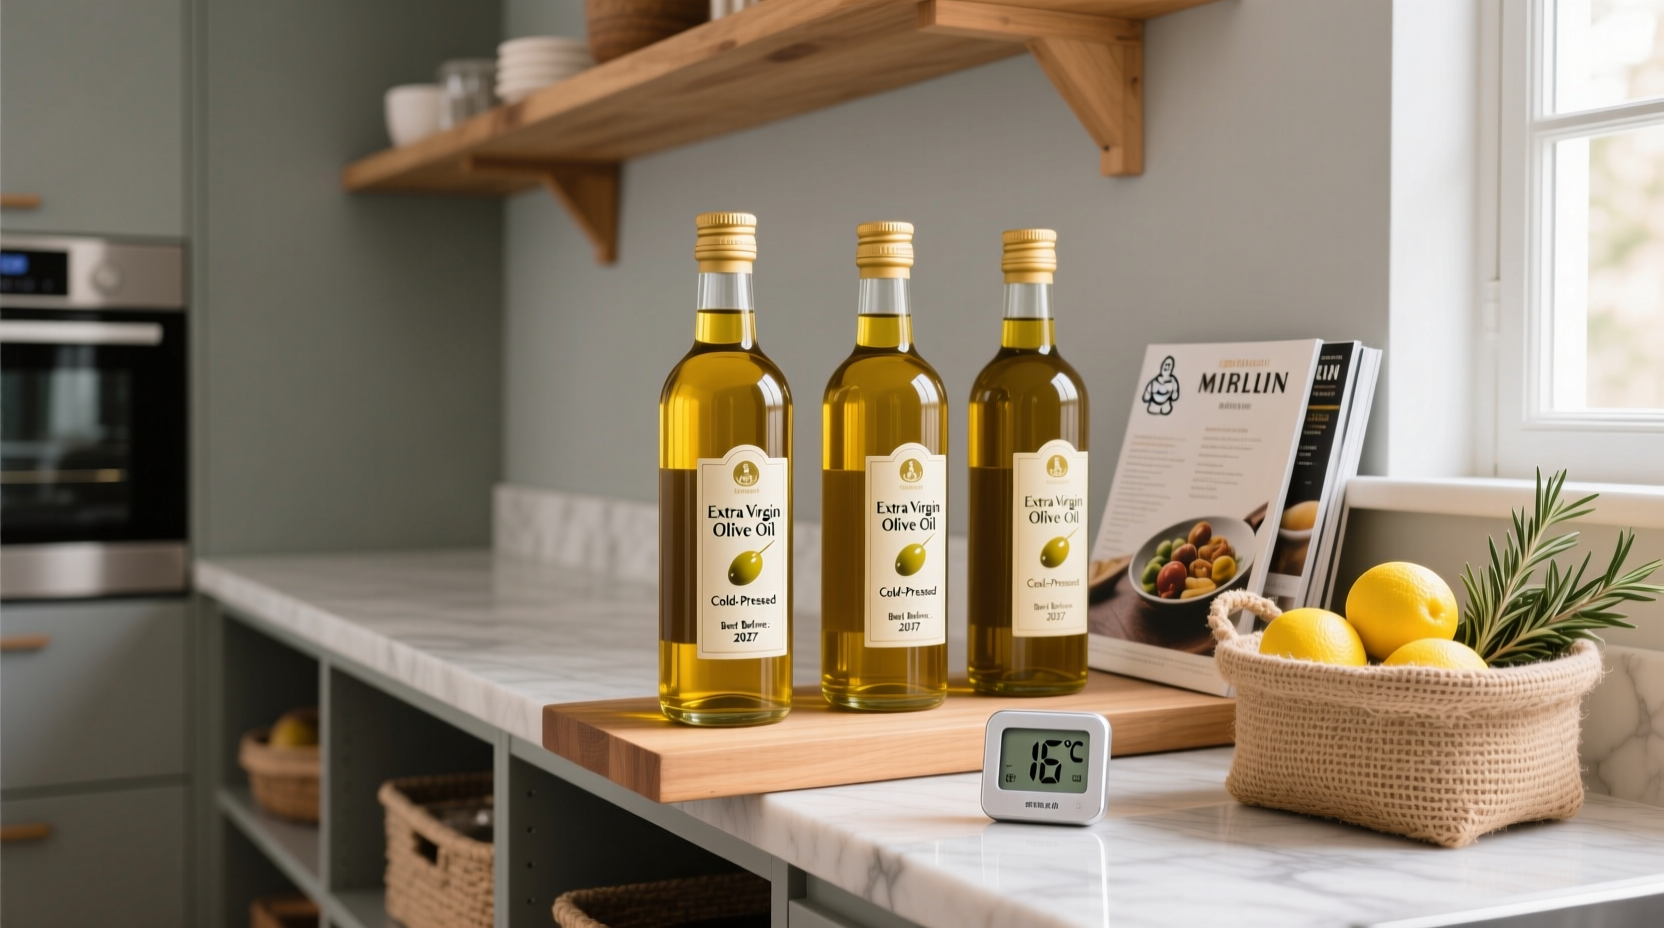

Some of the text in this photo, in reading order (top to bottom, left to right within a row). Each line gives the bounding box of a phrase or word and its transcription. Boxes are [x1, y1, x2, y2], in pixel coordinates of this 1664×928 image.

[1198, 371, 1289, 394] MIRLLIN
[876, 500, 940, 517] Extra Virgin
[1024, 494, 1083, 511] Extra Virgin
[707, 503, 781, 522] Extra Virgin
[1028, 510, 1079, 525] Olive Oil
[712, 521, 775, 538] Olive Oil
[881, 516, 936, 532] Olive Oil
